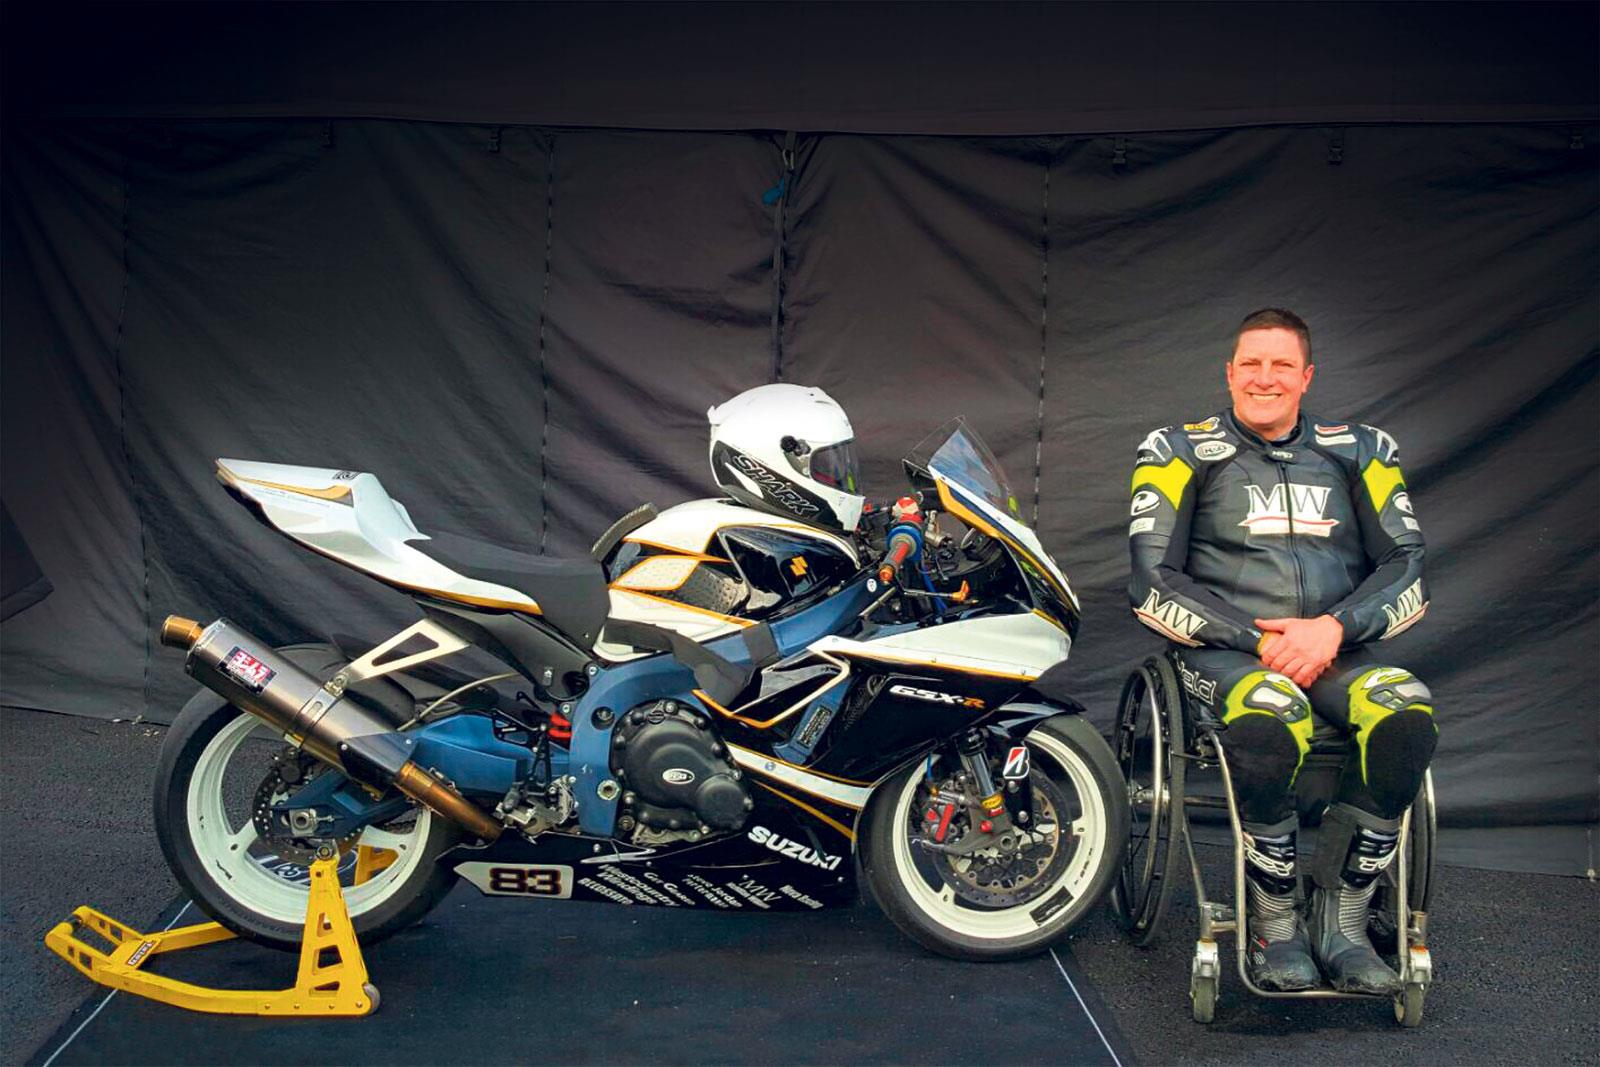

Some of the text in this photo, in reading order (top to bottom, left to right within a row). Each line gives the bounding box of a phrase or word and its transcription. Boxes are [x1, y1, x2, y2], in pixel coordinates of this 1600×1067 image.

[732, 455, 820, 515] SHARK
[1246, 485, 1331, 515] MW
[1143, 589, 1207, 637] MW
[1387, 580, 1425, 628] MW
[889, 684, 986, 708] GSX-R
[747, 825, 842, 871] SUZUKI
[488, 867, 563, 896] 83
